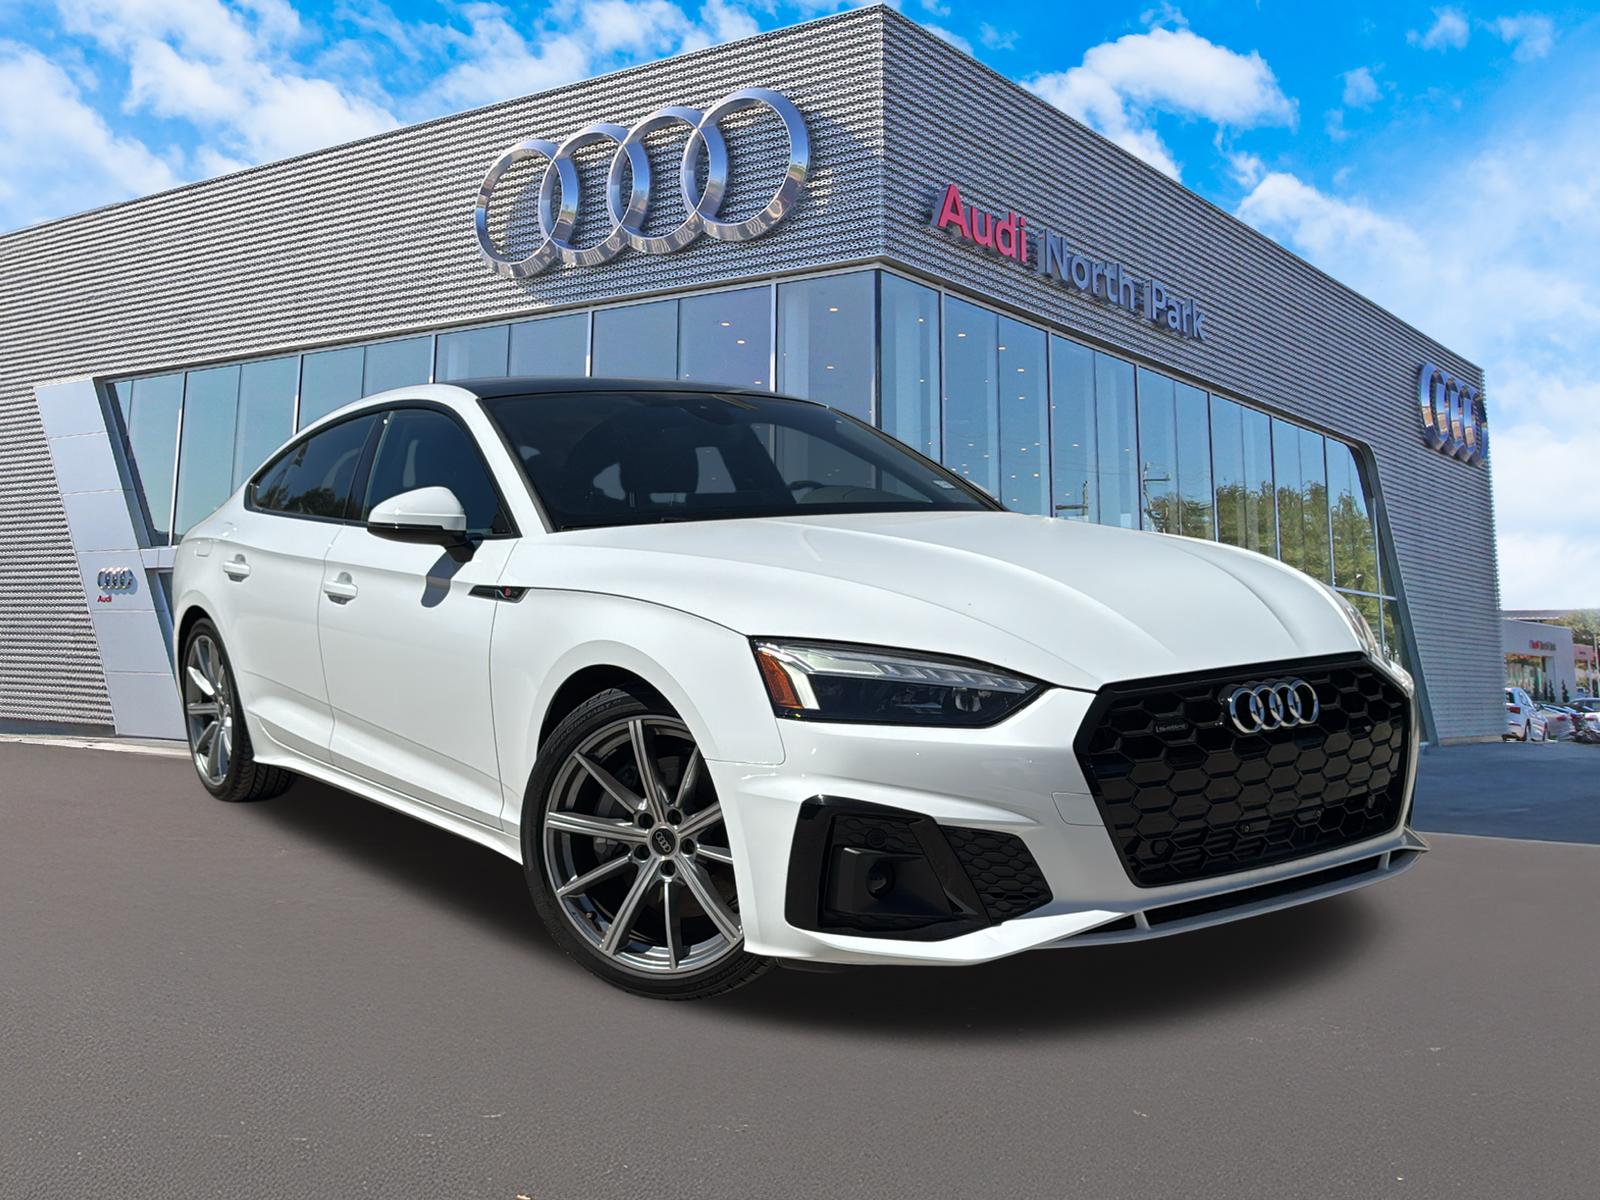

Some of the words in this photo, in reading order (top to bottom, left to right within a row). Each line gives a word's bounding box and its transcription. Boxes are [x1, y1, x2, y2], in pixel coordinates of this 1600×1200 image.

[931, 183, 1028, 264] Audi
[1040, 231, 1137, 312] North
[1146, 280, 1207, 340] Park
